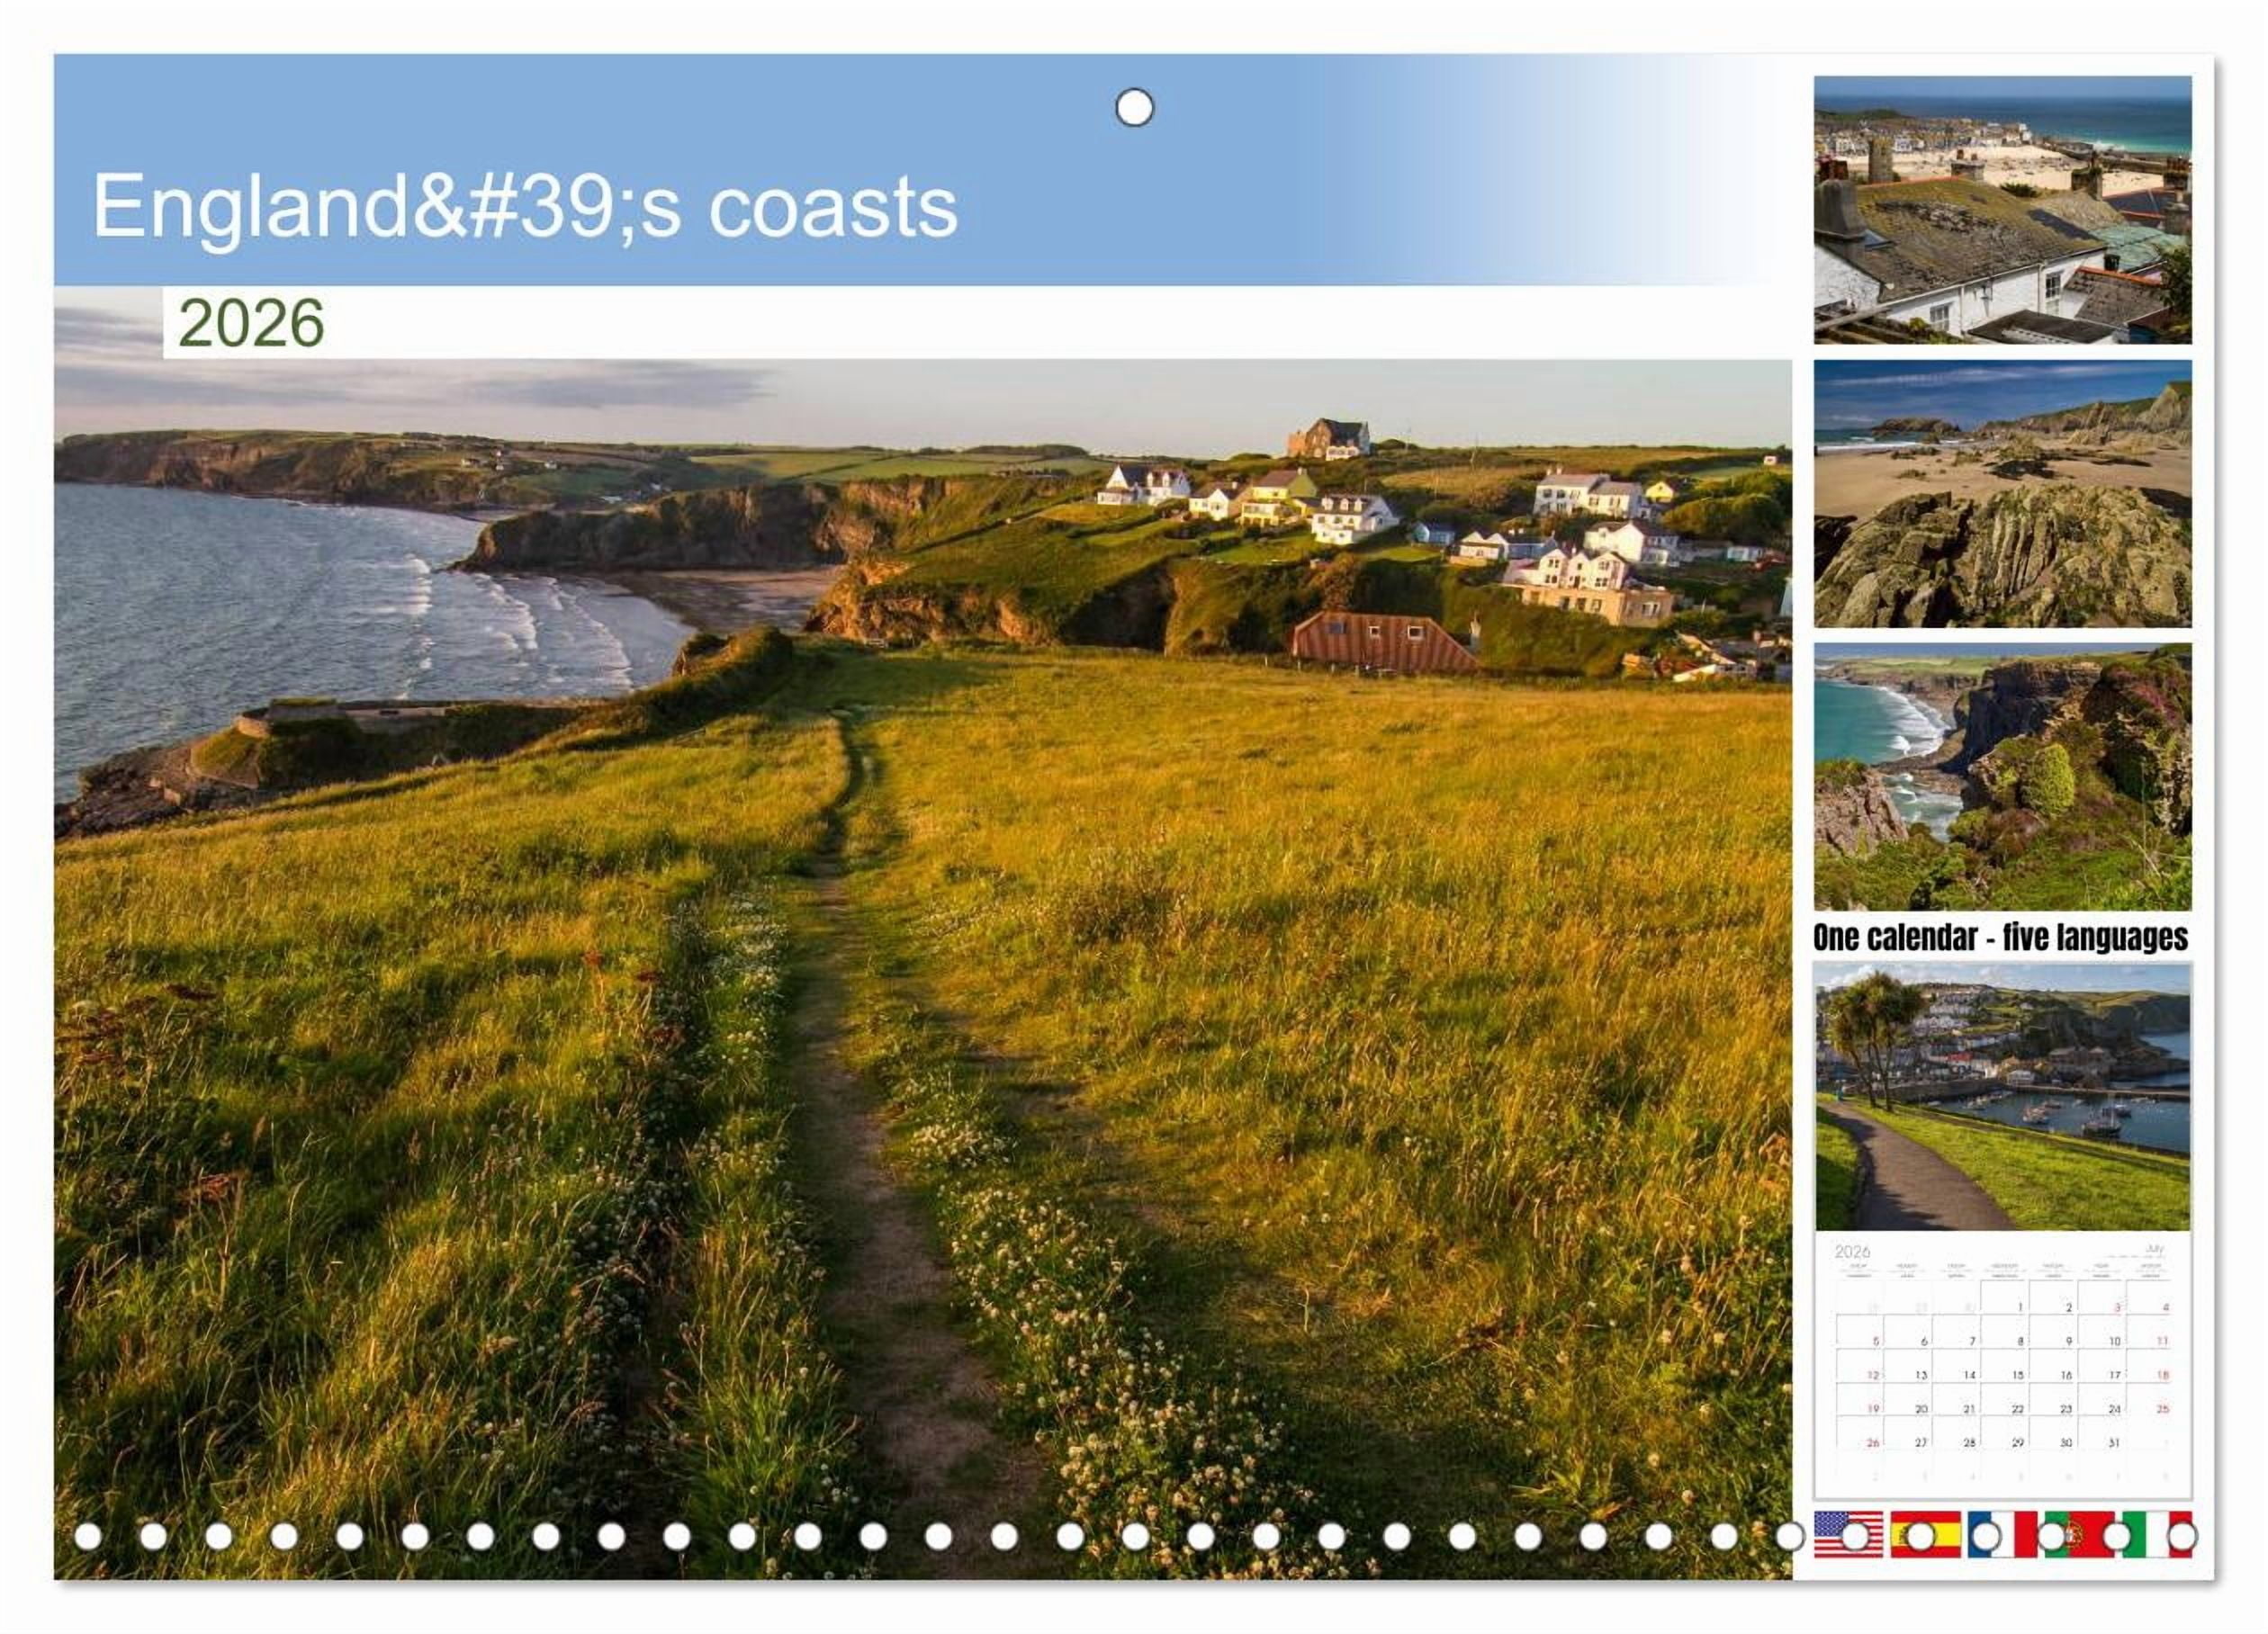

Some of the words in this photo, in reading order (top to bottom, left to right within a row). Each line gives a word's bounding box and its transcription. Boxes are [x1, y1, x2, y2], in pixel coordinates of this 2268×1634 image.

[95, 172, 680, 255] England&#39;s
[710, 176, 957, 238] coasts
[180, 298, 324, 347] 2026
[1814, 923, 1859, 951] One
[1868, 923, 1978, 951] calendar
[2003, 921, 2048, 951] five
[2057, 923, 2188, 955] languages
[1834, 1245, 1870, 1259] 2026
[2018, 1302, 2023, 1313] 1
[2066, 1302, 2073, 1313] 2
[2163, 1302, 2170, 1313] 4
[1921, 1336, 1929, 1347] 6
[1970, 1336, 1976, 1347] 7
[2017, 1336, 2024, 1347] 8
[2066, 1336, 2073, 1347] 9
[2110, 1336, 2121, 1347] 10
[1868, 1370, 1880, 1380] 12
[1916, 1370, 1928, 1380] 13
[1965, 1370, 1976, 1380] 14
[2013, 1370, 2024, 1380] 15
[2061, 1370, 2073, 1380] 16
[2110, 1370, 2121, 1380] 17
[1868, 1404, 1880, 1414] 19
[1915, 1404, 1929, 1414] 20
[1963, 1404, 1975, 1414] 21
[2012, 1404, 2024, 1414] 22
[2060, 1404, 2073, 1414] 23
[2109, 1404, 2121, 1414] 24
[1867, 1437, 1880, 1449] 26
[1914, 1437, 1927, 1449] 27
[1963, 1437, 1976, 1449] 28
[2012, 1437, 2025, 1449] 29
[2060, 1437, 2073, 1449] 30
[2109, 1437, 2120, 1449] 31
